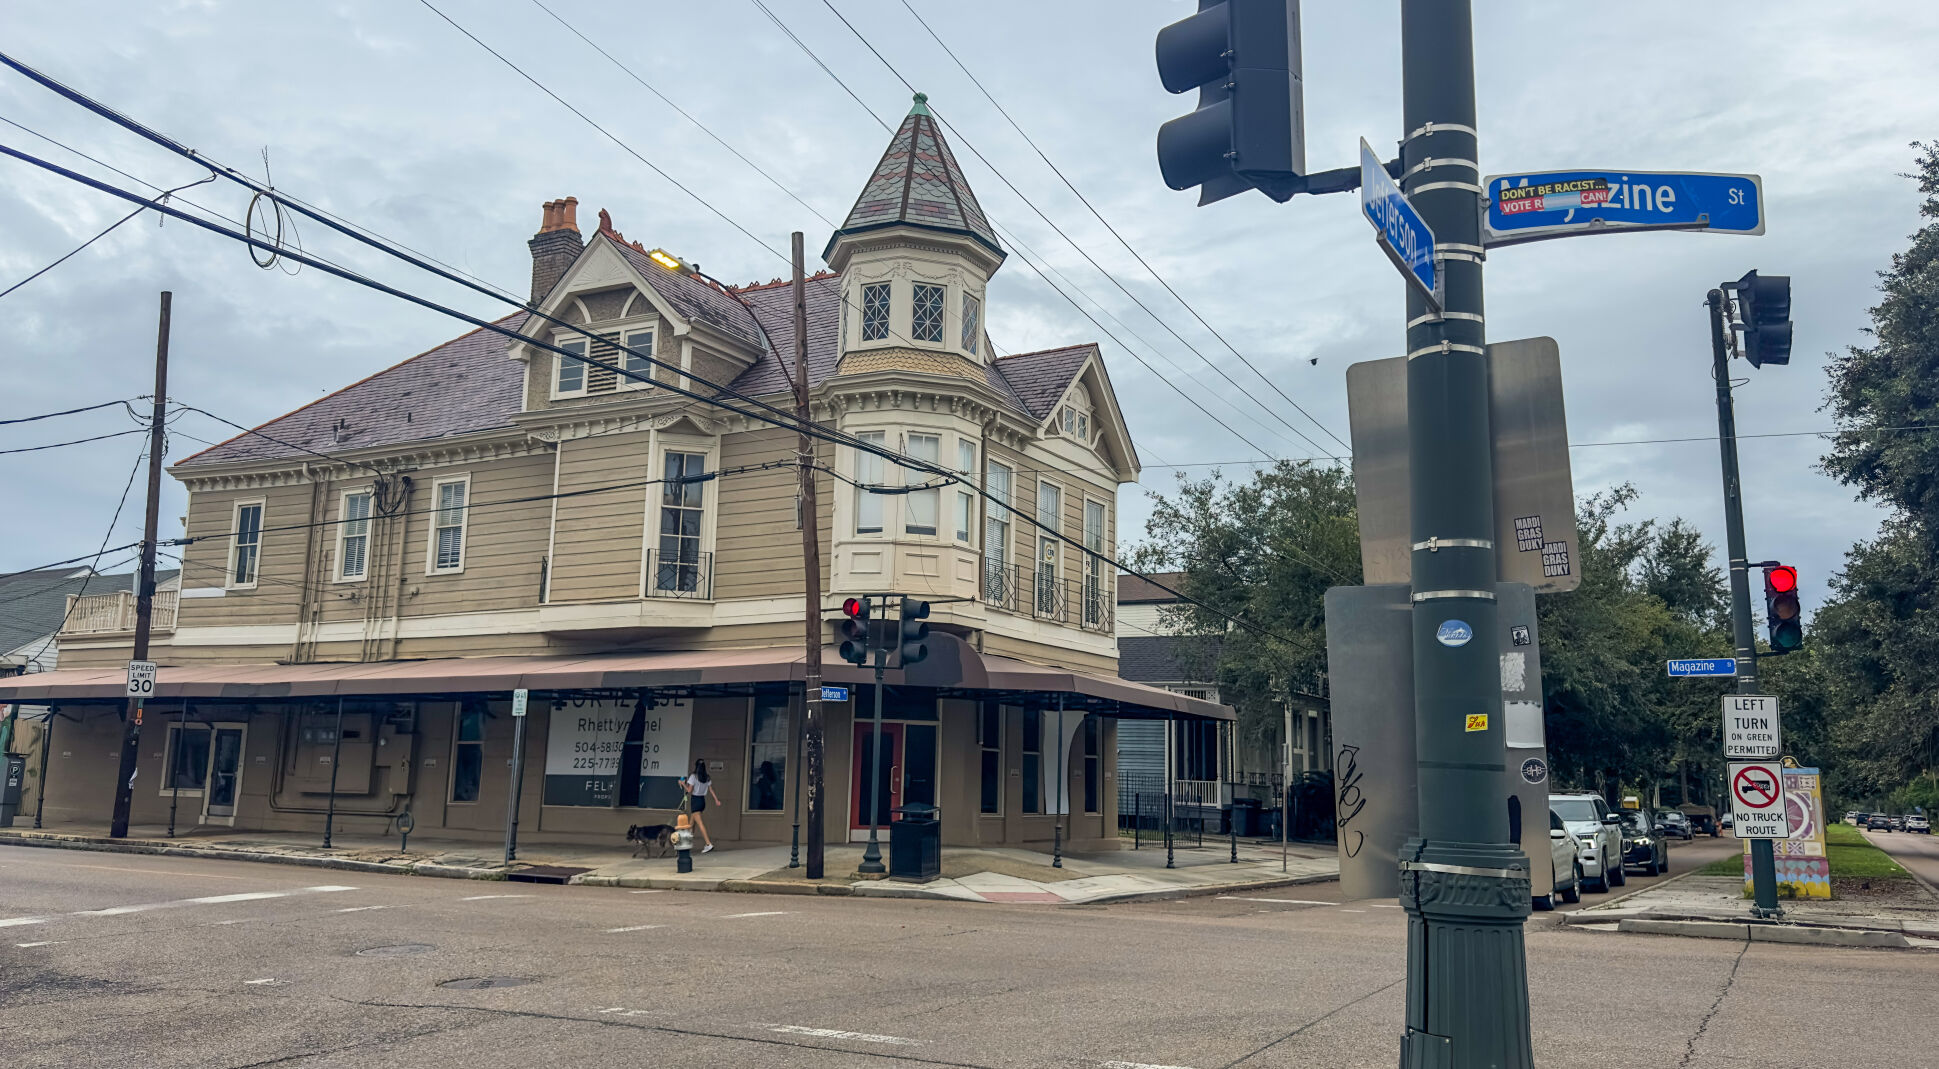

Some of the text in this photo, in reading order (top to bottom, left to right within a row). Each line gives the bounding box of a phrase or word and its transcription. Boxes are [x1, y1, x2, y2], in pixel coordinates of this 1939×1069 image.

[1502, 180, 1605, 200] DON'T BE RACIST...
[1728, 188, 1744, 205] St
[1503, 200, 1531, 213] VOTE
[1369, 167, 1417, 265] Jefferson
[1515, 516, 1540, 530] MARDI
[1517, 528, 1542, 541] GRAS
[1518, 538, 1543, 552] DUKY
[1541, 542, 1567, 555] MARDI
[1542, 553, 1568, 566] GRAS
[1544, 564, 1569, 577] DUKY
[131, 664, 154, 672] SPEED
[1671, 661, 1715, 675] Magazine
[129, 679, 152, 692] 30
[1735, 699, 1764, 711] LEFT
[1734, 717, 1768, 729] TURN
[1731, 733, 1773, 742] ON GREEN
[1727, 745, 1777, 755] PERMITTED
[1736, 812, 1784, 822] NO TRUCK
[1746, 826, 1777, 835] ROUTE
